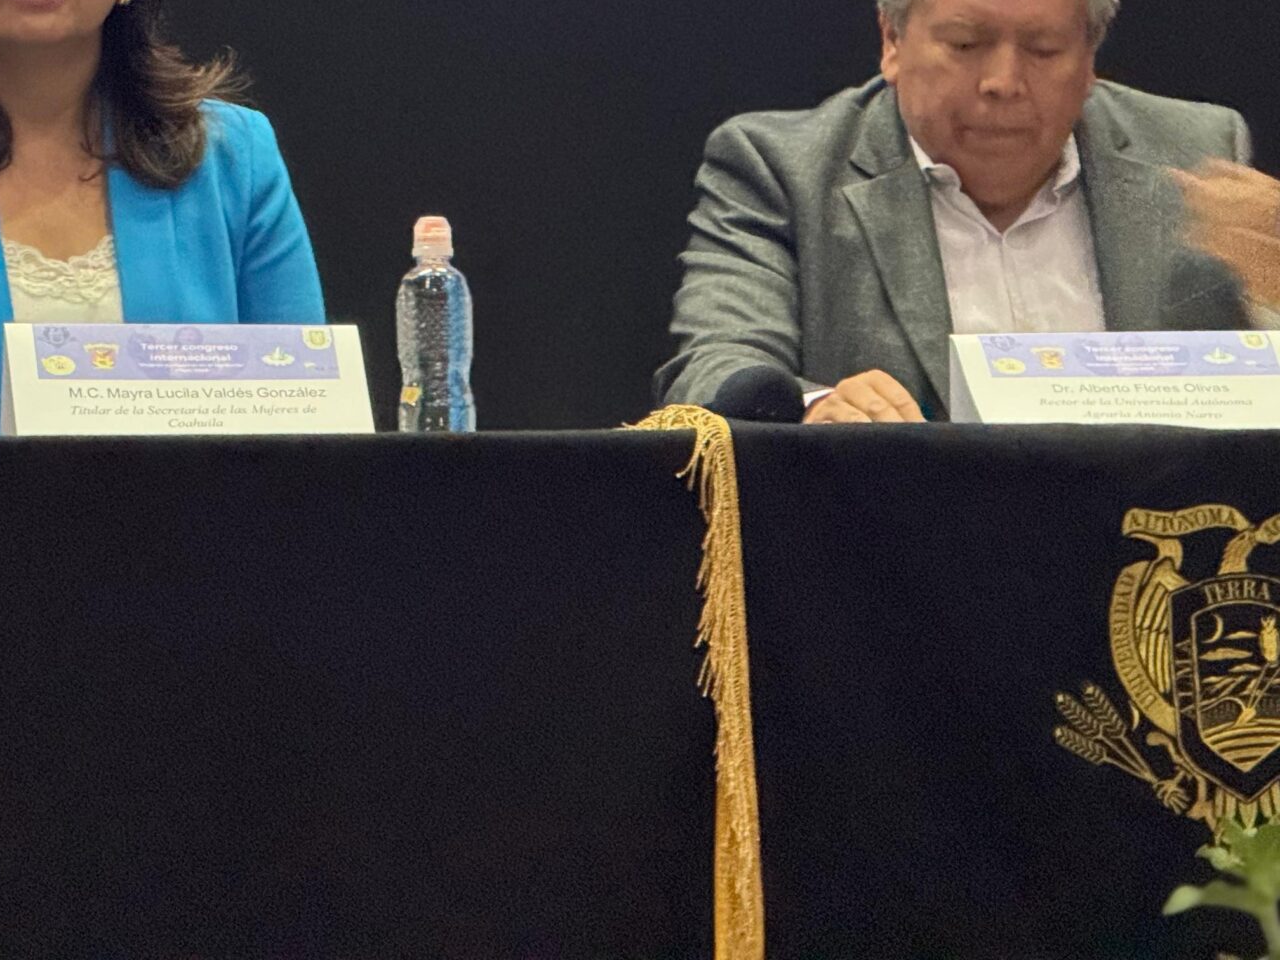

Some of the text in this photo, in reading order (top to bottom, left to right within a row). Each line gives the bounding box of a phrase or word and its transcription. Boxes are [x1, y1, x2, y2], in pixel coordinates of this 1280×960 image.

[182, 344, 238, 353] congreso
[69, 386, 328, 401] M.C. Mayra Lucila Valdés González
[1051, 383, 1230, 393] Dr. Alberto Flores Olivas
[114, 405, 130, 415] de
[133, 405, 144, 415] la
[212, 404, 227, 415] de
[230, 404, 247, 414] las
[252, 404, 299, 416] Mujeres
[303, 404, 317, 414] de
[168, 418, 224, 428] Coahuila
[1128, 507, 1237, 533] AUTONOMA
[1202, 578, 1271, 604] TERRA
[1113, 571, 1158, 710] UNIVERSIDAD
